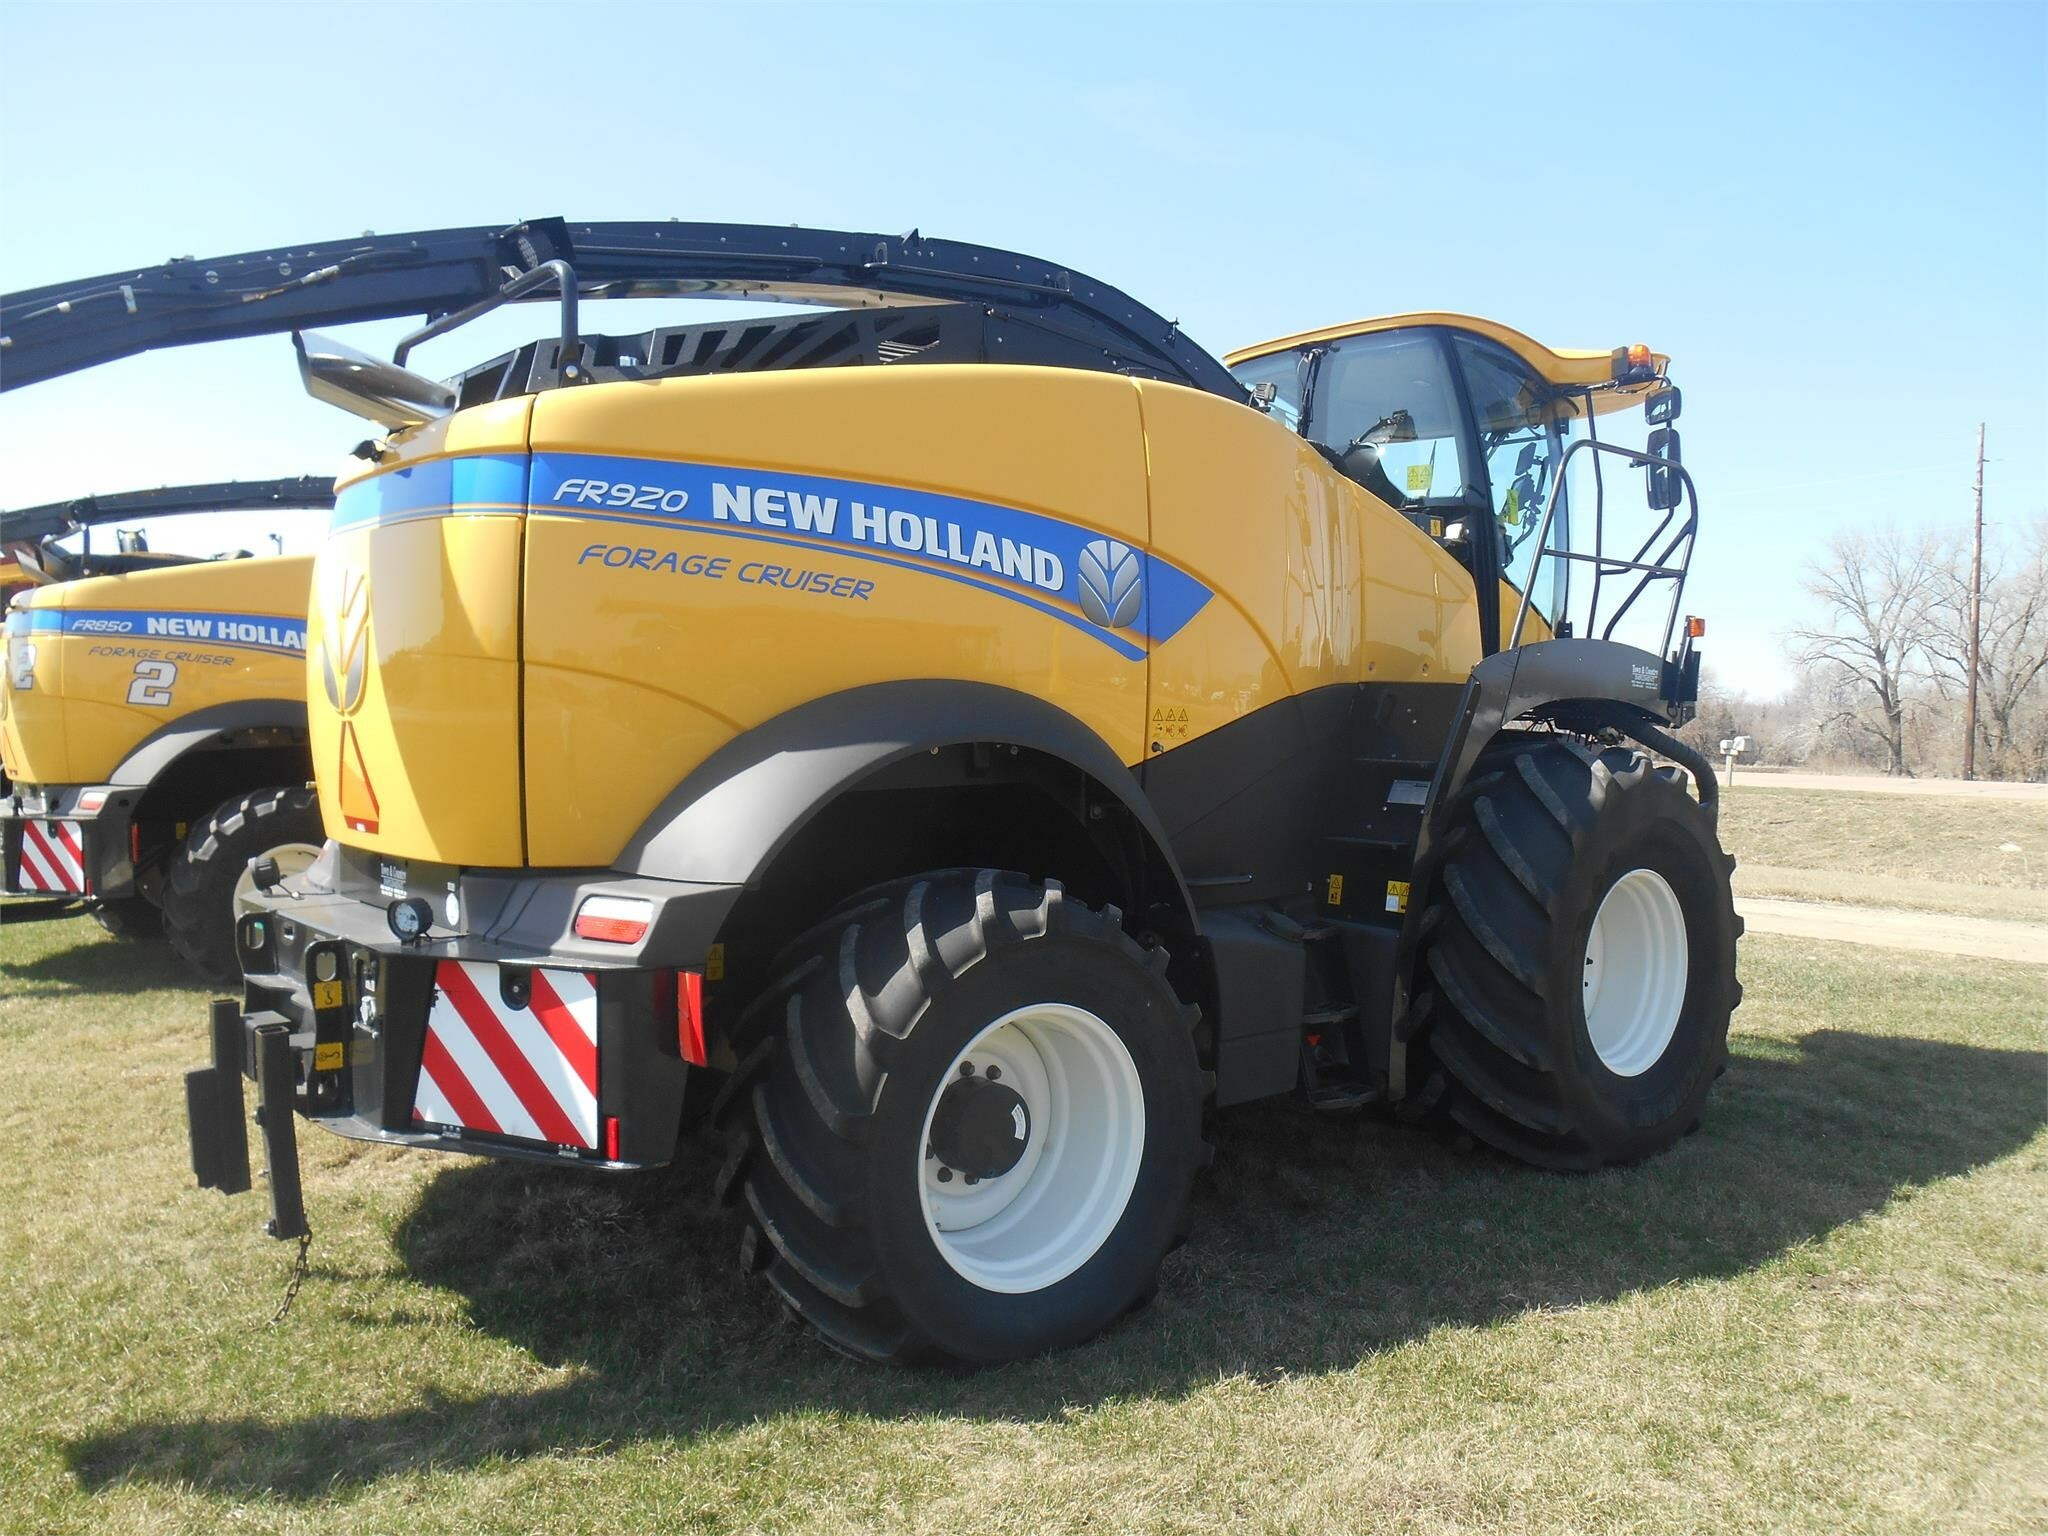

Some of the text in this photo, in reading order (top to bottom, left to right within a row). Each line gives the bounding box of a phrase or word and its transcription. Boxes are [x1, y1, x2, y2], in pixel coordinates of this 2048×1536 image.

[554, 478, 1066, 593] FR920 NEW HOLLAND
[578, 544, 875, 600] FORAGE CRUISER
[71, 619, 132, 633] FR850
[146, 617, 211, 640] NEW
[88, 646, 236, 667] FORAGE CRUISER
[126, 659, 178, 706] 2
